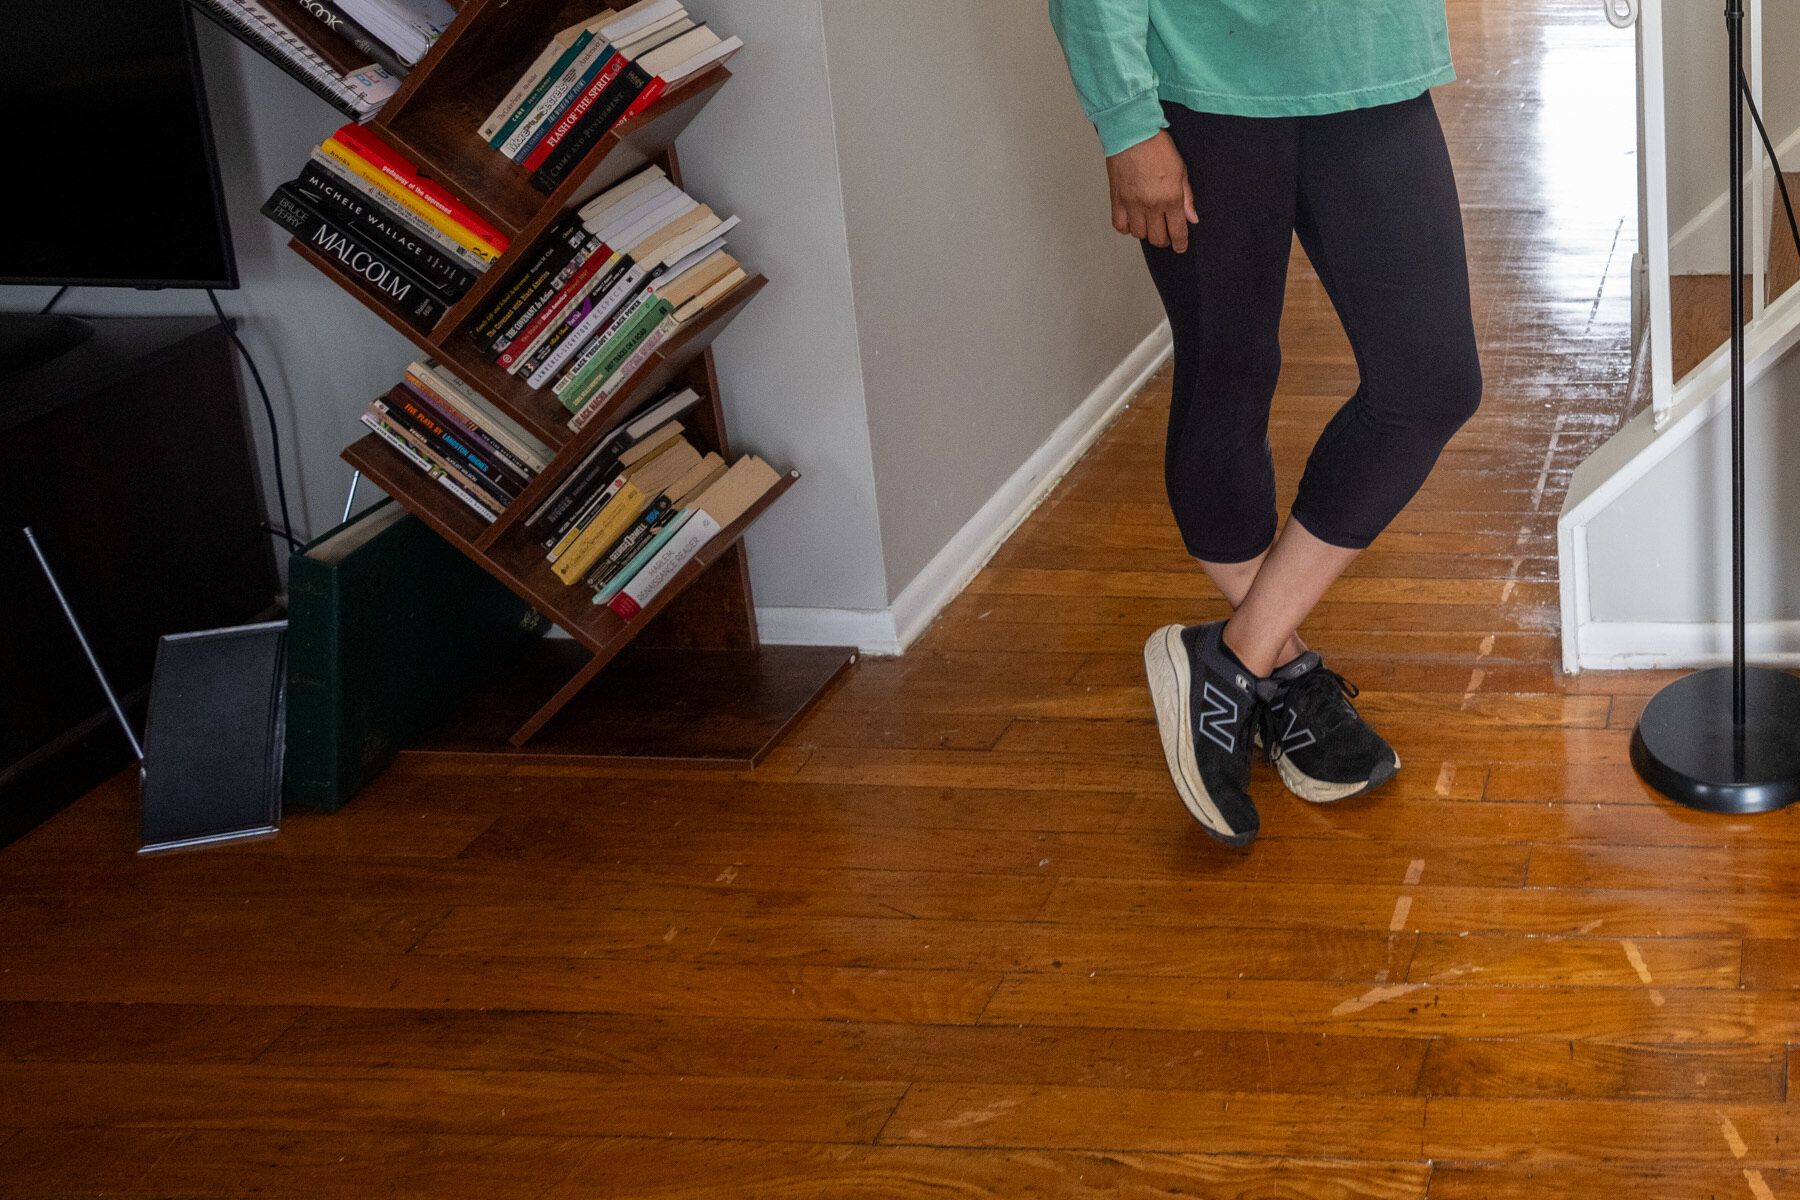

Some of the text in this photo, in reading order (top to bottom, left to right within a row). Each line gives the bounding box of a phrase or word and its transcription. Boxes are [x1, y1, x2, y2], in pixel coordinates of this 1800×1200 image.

[577, 40, 602, 66] Anderson
[535, 75, 552, 93] Toomer
[545, 120, 571, 147] FLASH
[564, 110, 579, 125] OF
[573, 95, 593, 115] THE
[586, 71, 613, 100] SPIRIT
[505, 126, 531, 153] More
[536, 80, 569, 115] Secrets
[511, 107, 525, 122] CANE
[548, 150, 574, 178] CRIME
[581, 90, 627, 139] PUNISHMENT
[329, 149, 351, 167] hooks
[278, 197, 309, 222] BRUCE
[360, 170, 392, 195] Teaching
[391, 191, 400, 200] to
[381, 164, 452, 216] pedagogy of the oppressed
[272, 204, 303, 230] PERRY
[308, 173, 363, 216] MICHELE
[365, 212, 423, 257] WALLACE
[311, 222, 412, 302] MALCOLM
[485, 312, 495, 321] Life
[492, 305, 501, 314] and
[498, 293, 512, 307] School
[486, 269, 550, 338] The Covenant with Black America
[505, 326, 517, 339] THE
[513, 304, 538, 331] COVENANT
[537, 286, 555, 304] Action
[533, 320, 592, 382] LAWRENCE-LIGHTFOOT
[591, 285, 624, 320] RESPECT
[571, 356, 588, 374] BLACK
[584, 334, 609, 360] THEOLOGY
[610, 314, 627, 332] BLACK
[623, 298, 642, 317] POWER
[604, 360, 616, 372] DUST
[612, 347, 628, 364] TRACKS
[625, 341, 633, 350] ON
[633, 326, 647, 340] ROAD
[574, 406, 594, 426] BLACK
[588, 390, 609, 411] MACHO
[404, 402, 417, 415] FIVE
[415, 412, 435, 430] PLAYS
[432, 425, 443, 436] BY
[440, 432, 469, 457] LANGSTON
[466, 452, 489, 473] HUGHES
[635, 557, 679, 602] RENAISSANCE
[674, 535, 700, 562] READER
[647, 548, 675, 577] HARLEM
[1200, 681, 1238, 754] N
